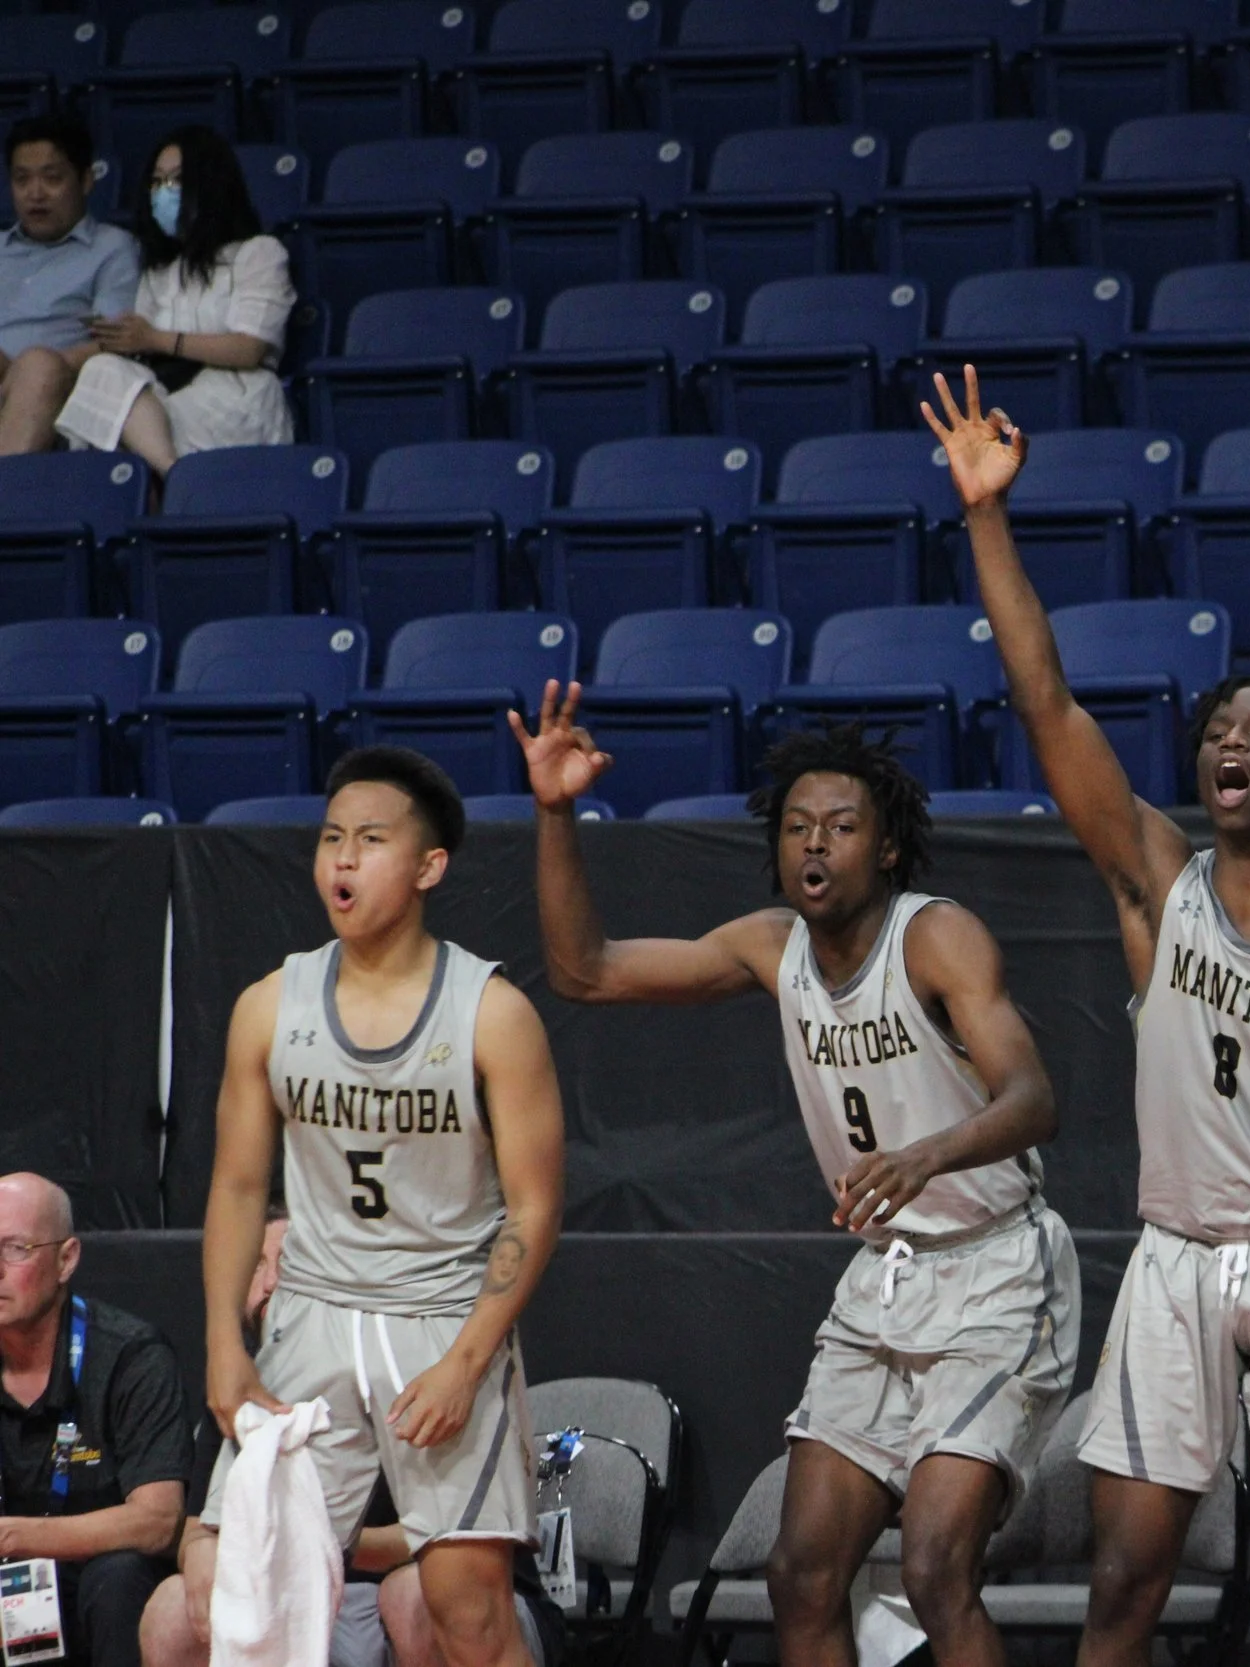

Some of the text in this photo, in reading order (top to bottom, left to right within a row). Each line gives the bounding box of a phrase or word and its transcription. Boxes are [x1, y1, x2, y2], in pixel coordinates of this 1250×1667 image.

[1213, 1032, 1241, 1100] 8
[286, 1076, 461, 1133] MANITOBA
[843, 1086, 877, 1152] 9
[346, 1150, 389, 1219] 5
